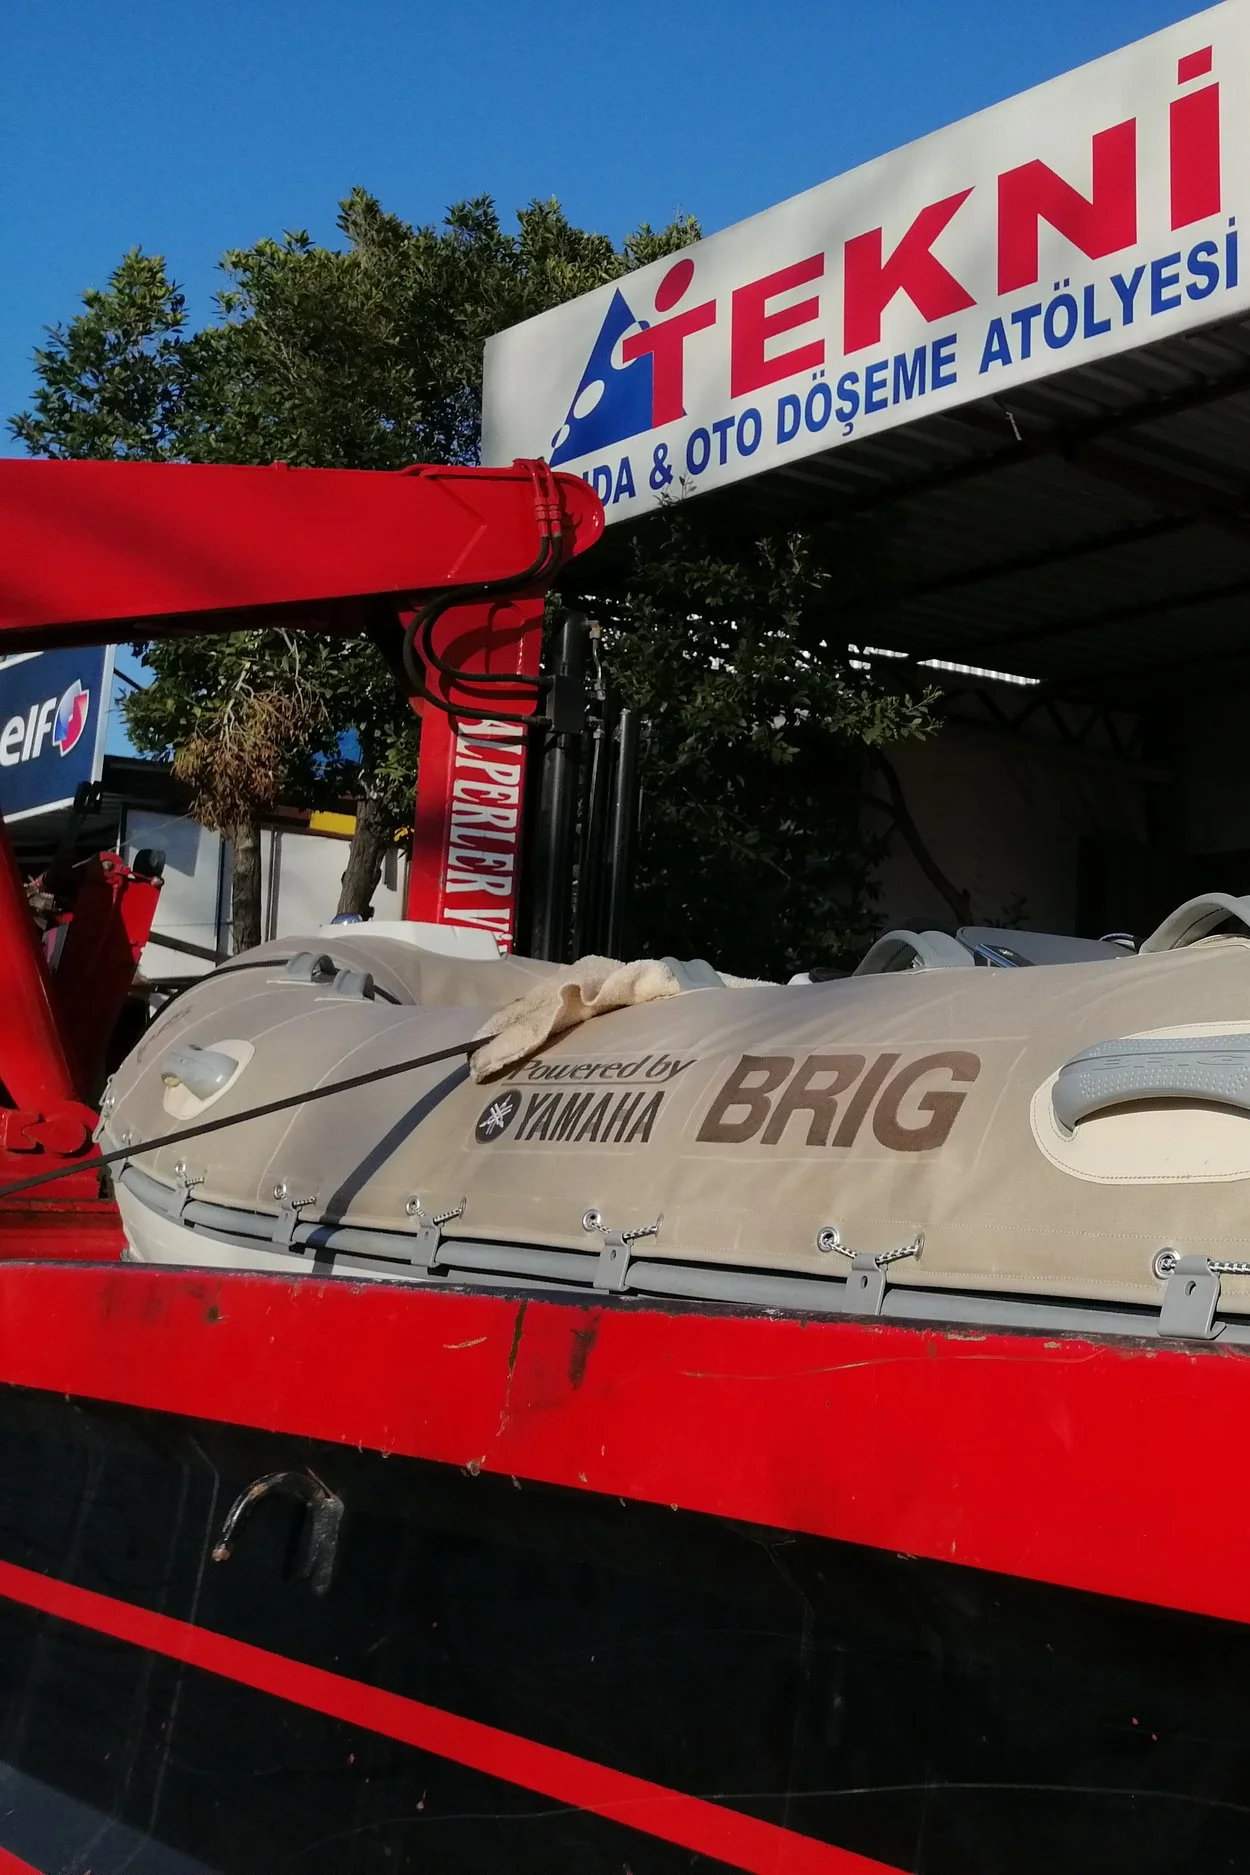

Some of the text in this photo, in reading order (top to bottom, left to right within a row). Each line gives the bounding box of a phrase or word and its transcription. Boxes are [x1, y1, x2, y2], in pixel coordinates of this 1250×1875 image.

[649, 442, 674, 490] &
[686, 408, 762, 475] OTO
[777, 333, 957, 445] DÖŞEME
[979, 216, 1238, 374] ATÖLYESİ
[0, 697, 57, 767] elf
[446, 719, 524, 896] ALPERLER
[507, 1054, 698, 1083] Powered by
[695, 1050, 982, 1152] BRIG
[514, 1090, 665, 1143] YAMAHA
